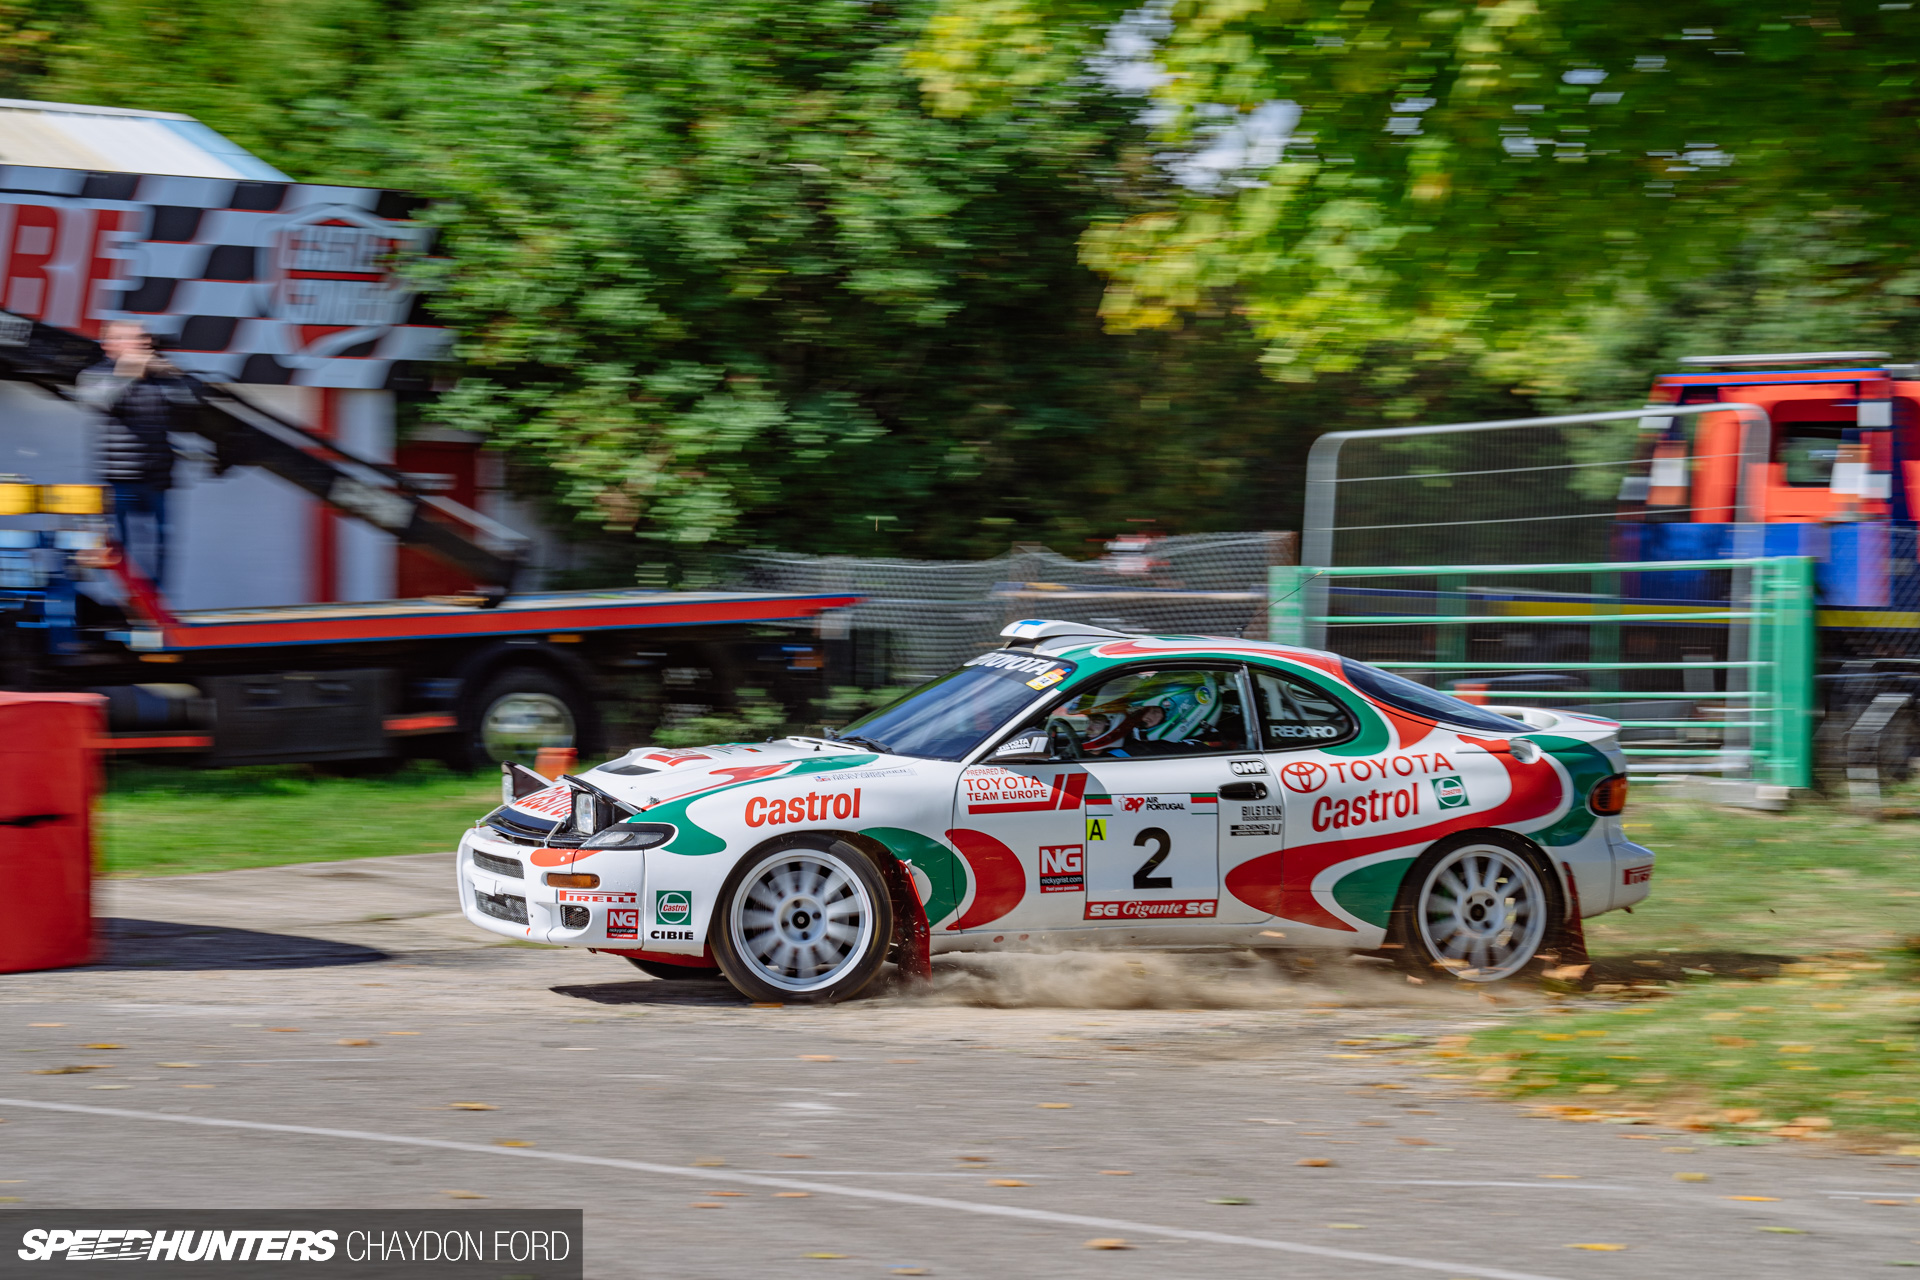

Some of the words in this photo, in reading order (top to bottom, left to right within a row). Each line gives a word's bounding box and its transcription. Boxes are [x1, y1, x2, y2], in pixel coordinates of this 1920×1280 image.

[1269, 725, 1338, 738] RECARO
[1330, 752, 1455, 783] TOYOTA
[963, 775, 1043, 791] TOYOTA
[967, 792, 999, 801] TEAM
[1002, 789, 1048, 800] EUROPE
[1146, 796, 1158, 804] AIR
[744, 788, 861, 828] Castrol
[1146, 803, 1186, 811] PORTUGAL
[1242, 805, 1282, 816] BILSTEIN
[1312, 782, 1419, 832] Castrol
[1089, 819, 1104, 841] A
[1041, 848, 1082, 874] NG
[1133, 827, 1173, 889] 2
[1041, 876, 1083, 885] nickygrist.com
[559, 889, 637, 903] PIRELLI
[663, 904, 688, 912] Castrol
[1089, 904, 1119, 917] SG
[1122, 901, 1183, 918] Gigante
[1184, 902, 1215, 914] SG
[609, 911, 636, 927] NG
